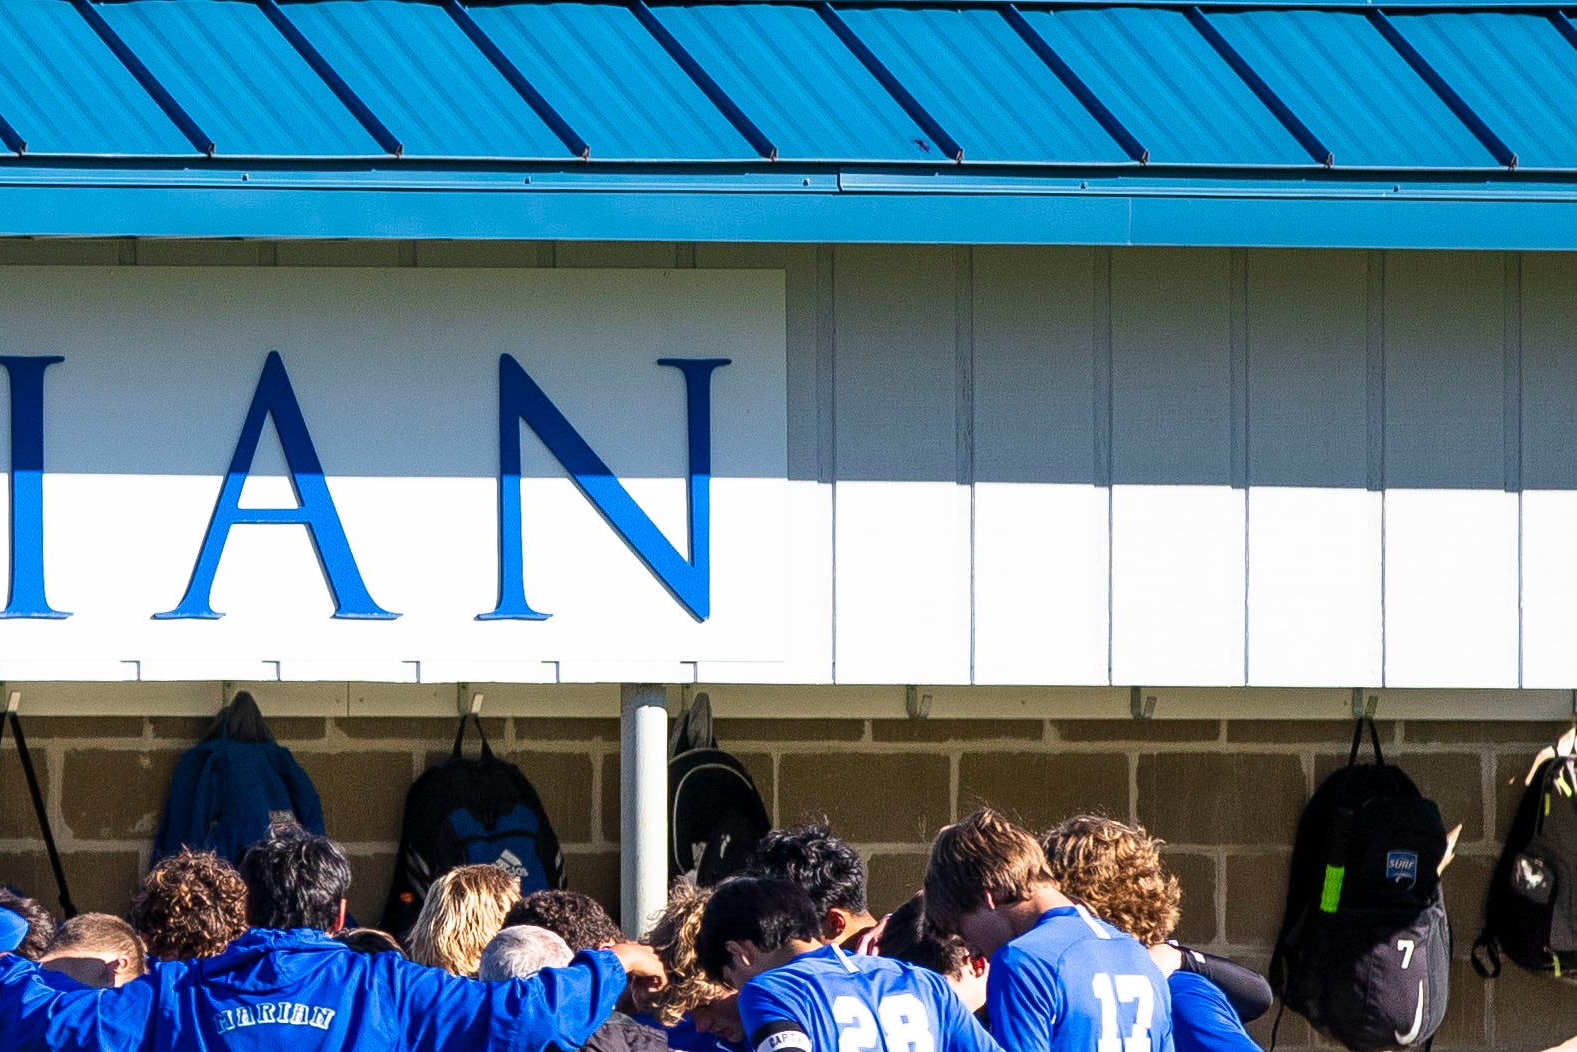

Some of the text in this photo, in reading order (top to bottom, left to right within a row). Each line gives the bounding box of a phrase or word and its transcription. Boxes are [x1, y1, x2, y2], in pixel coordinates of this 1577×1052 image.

[1388, 857, 1415, 870] SURF
[1397, 939, 1415, 970] 7
[214, 1001, 336, 1034] MARIAN
